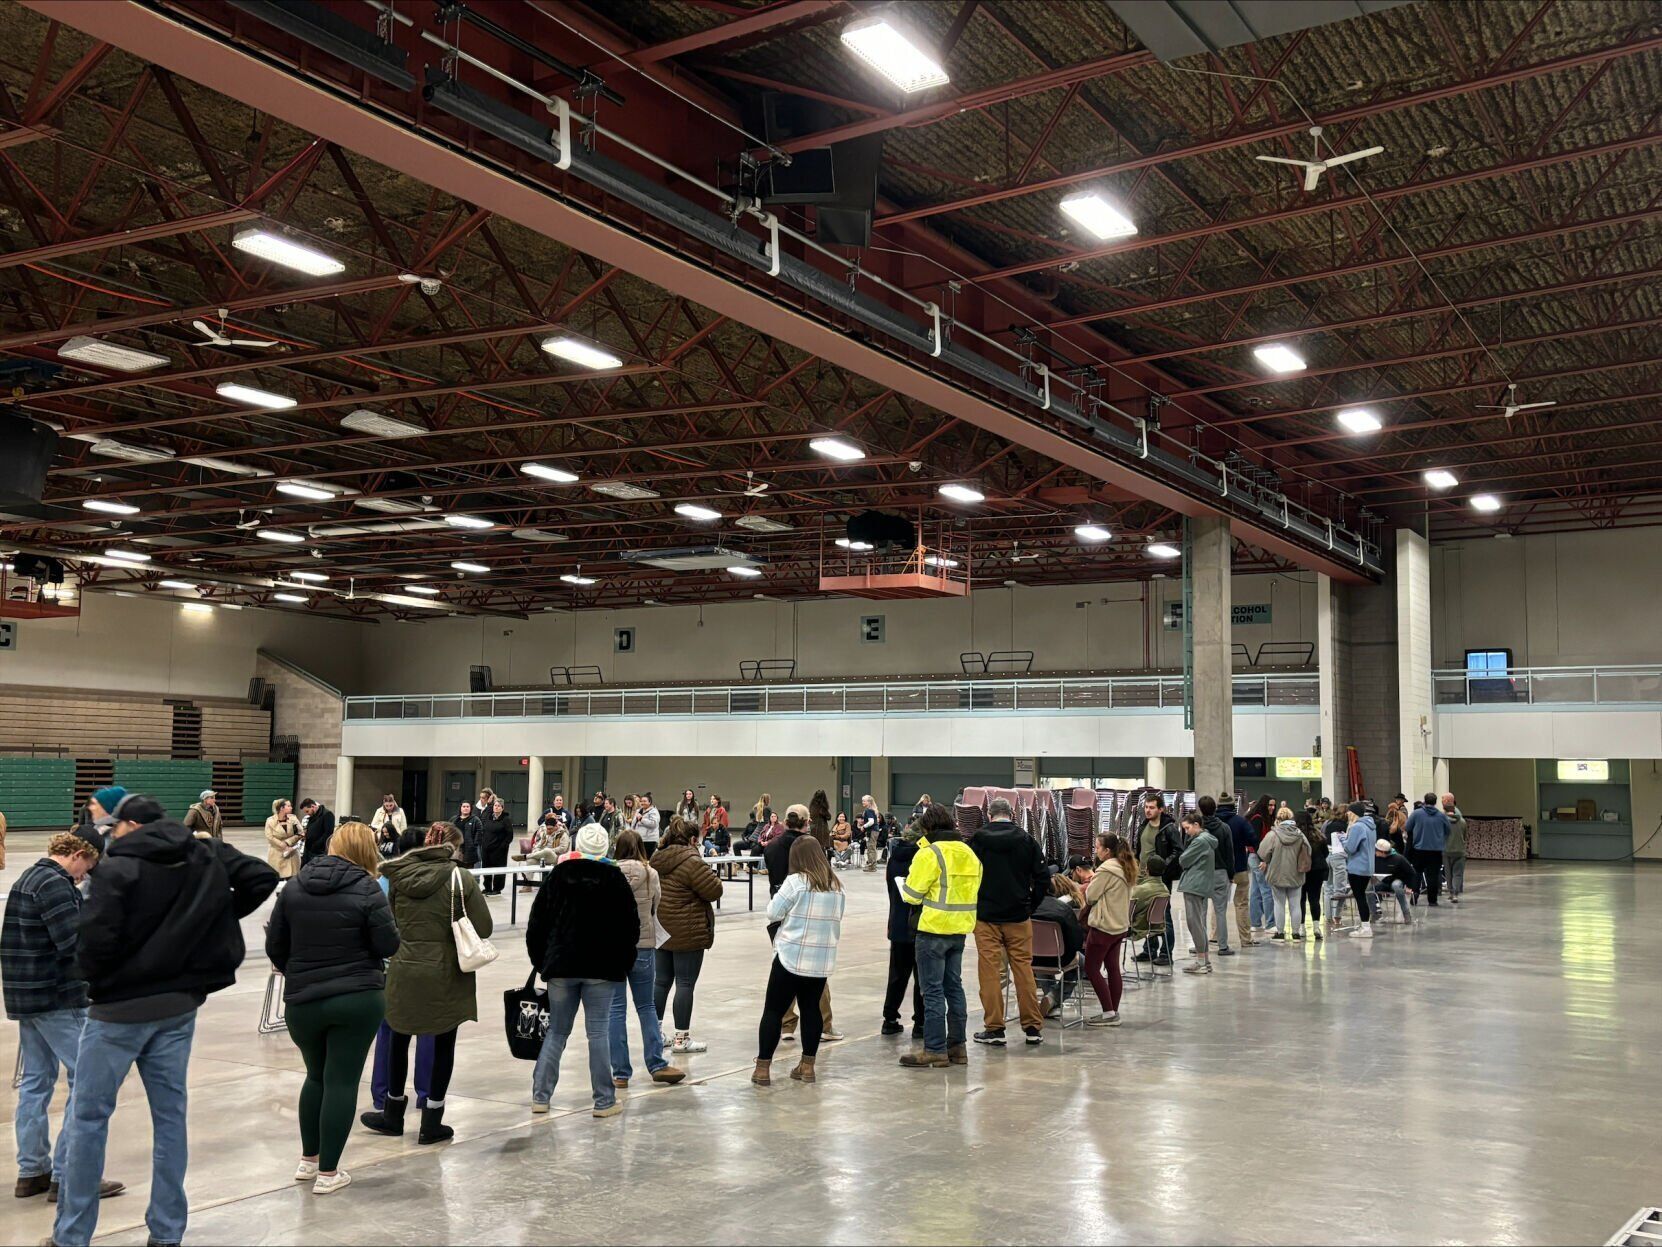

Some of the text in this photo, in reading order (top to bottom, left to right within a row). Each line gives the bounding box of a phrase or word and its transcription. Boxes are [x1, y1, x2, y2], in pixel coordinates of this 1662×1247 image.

[1231, 605, 1267, 614] COHOL
[0, 624, 11, 646] C
[866, 619, 879, 640] E
[619, 631, 631, 650] D
